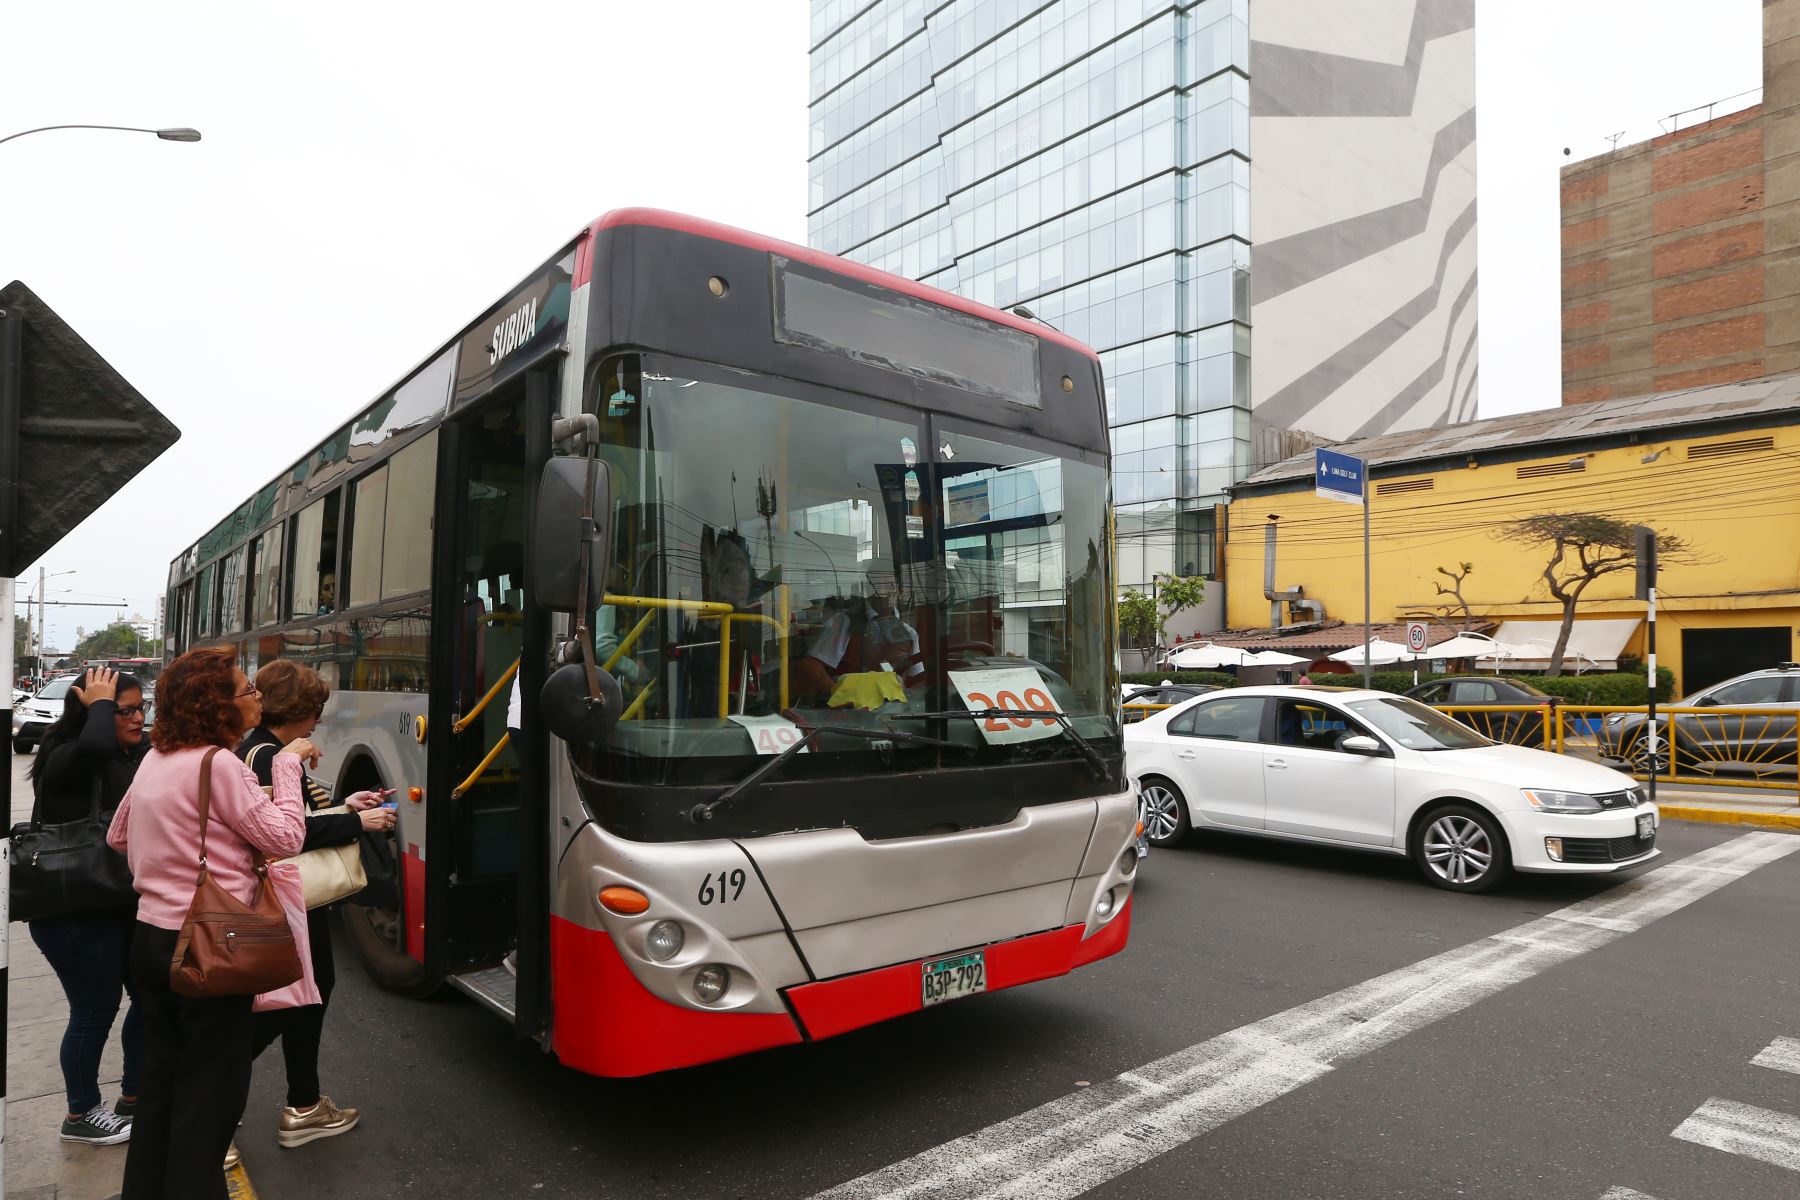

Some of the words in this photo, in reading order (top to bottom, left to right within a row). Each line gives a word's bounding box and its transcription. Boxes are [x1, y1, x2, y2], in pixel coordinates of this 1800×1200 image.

[490, 297, 537, 366] SUBIDA
[1412, 629, 1422, 641] 60
[399, 711, 410, 735] 619
[966, 688, 1057, 732] 209
[698, 868, 746, 906] 619
[925, 963, 983, 999] B3P-792
